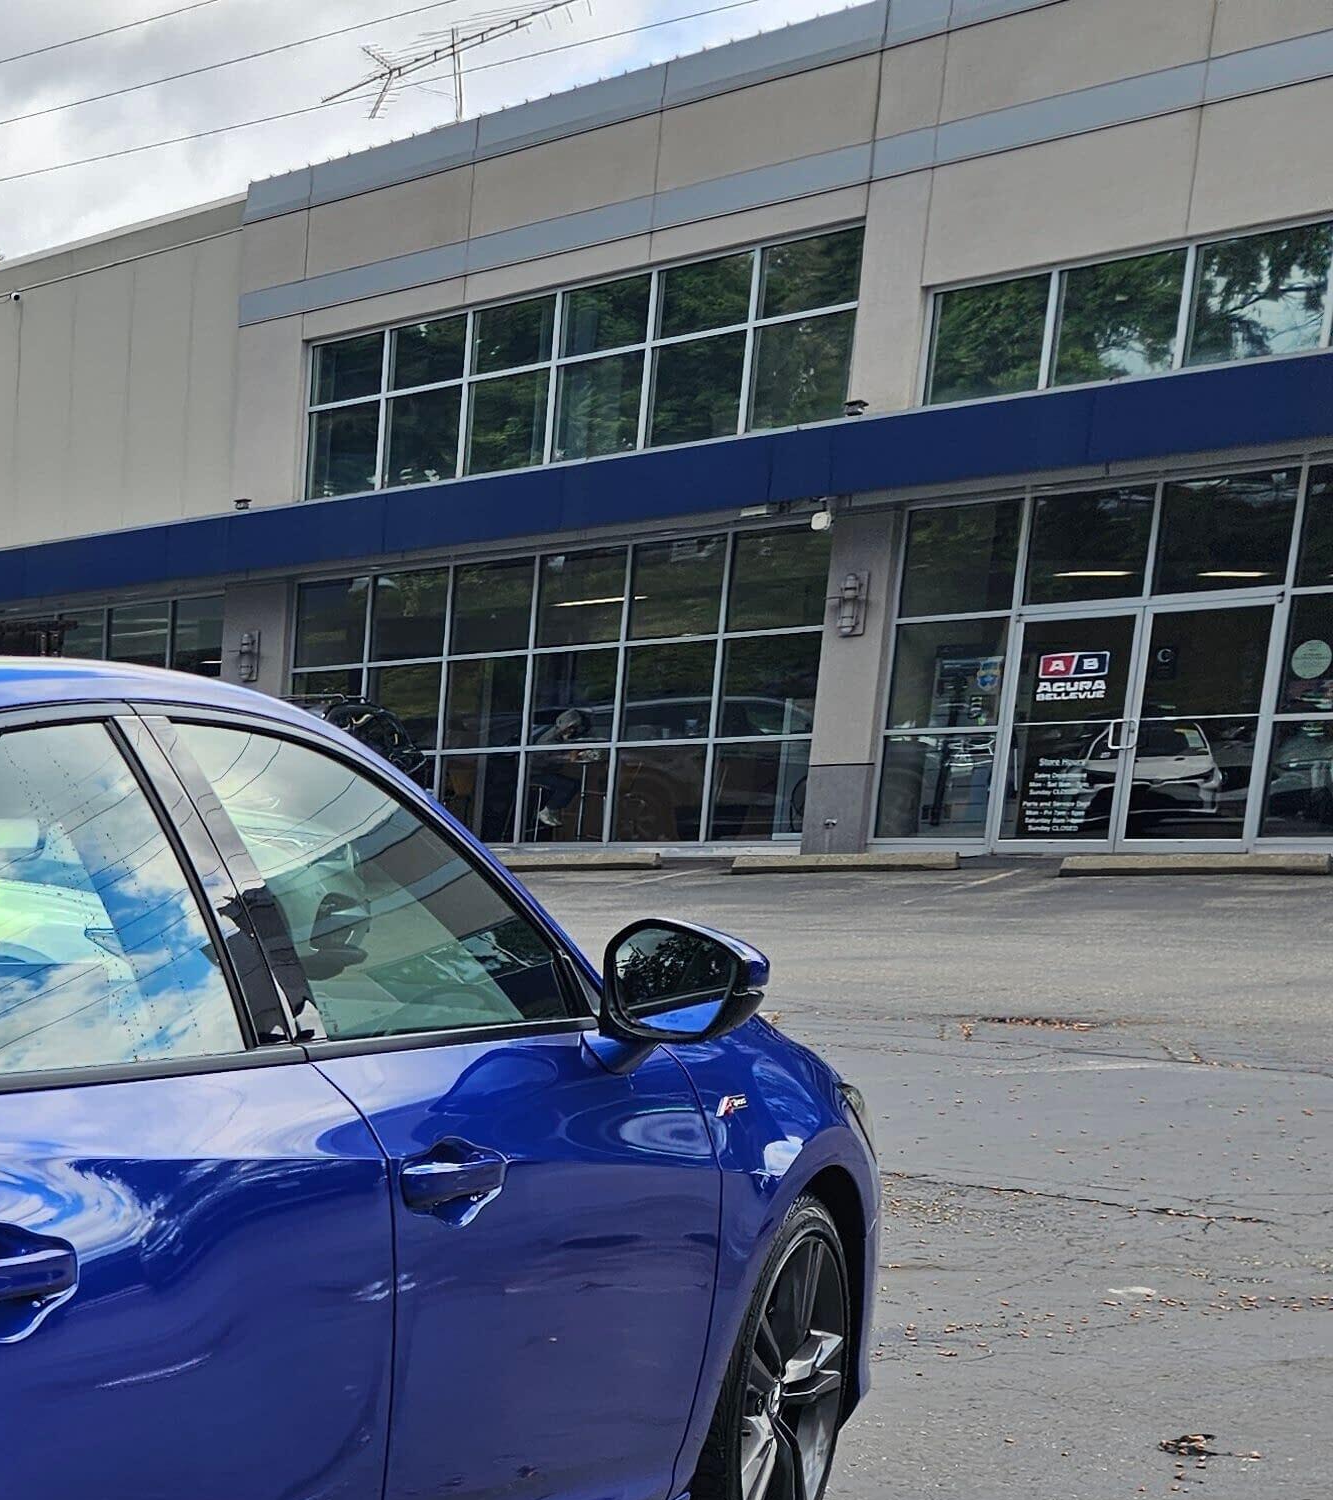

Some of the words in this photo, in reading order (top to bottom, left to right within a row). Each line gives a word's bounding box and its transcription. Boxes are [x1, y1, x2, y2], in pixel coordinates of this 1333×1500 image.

[1048, 659, 1066, 672] A
[1083, 657, 1099, 670] B
[1036, 680, 1106, 693] ACURA
[1035, 690, 1106, 701] BELLEVUE
